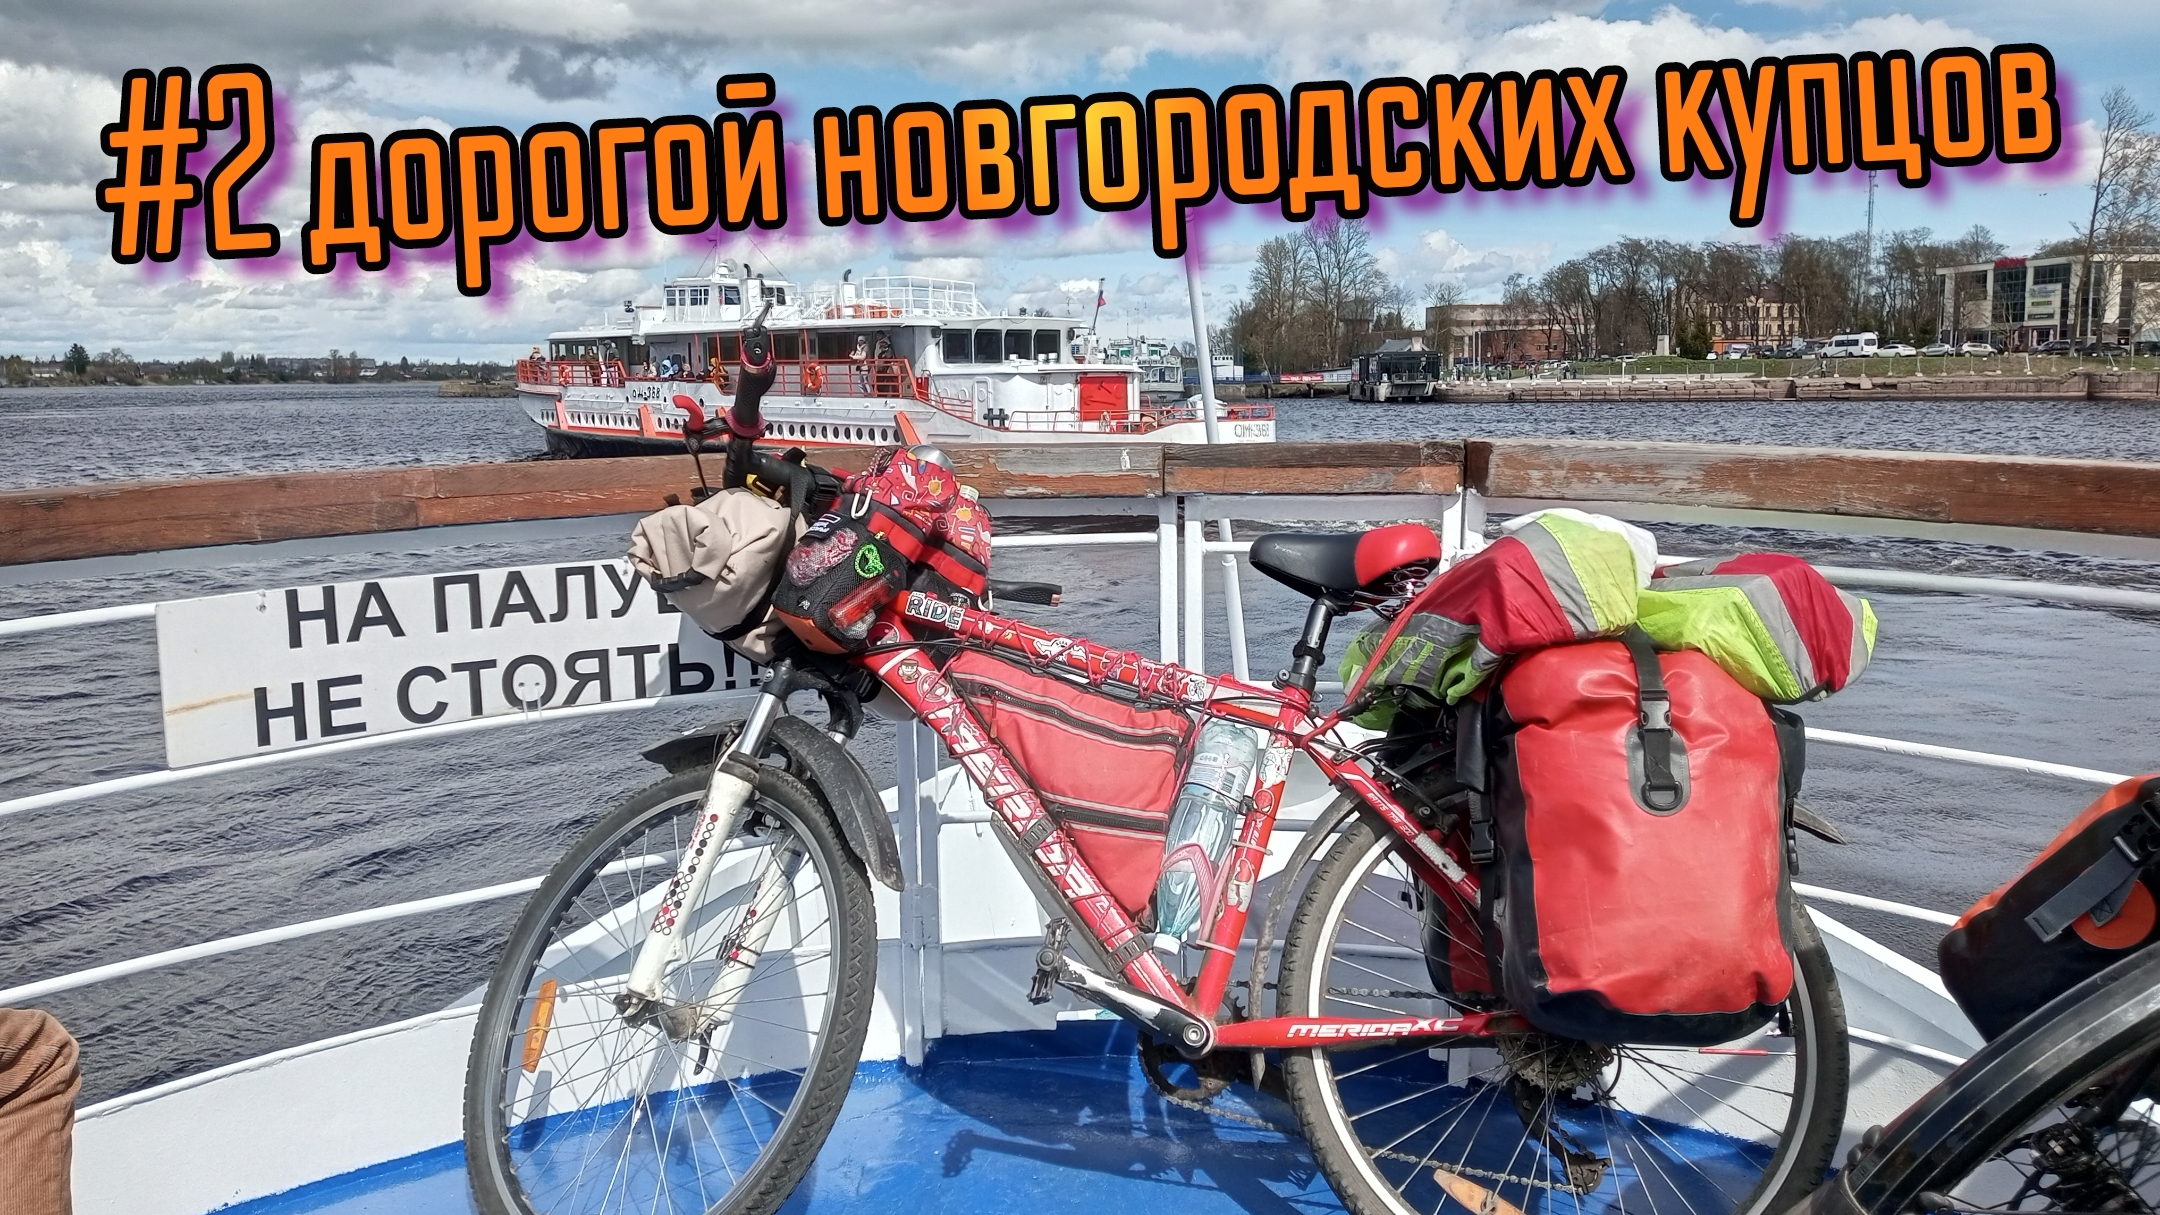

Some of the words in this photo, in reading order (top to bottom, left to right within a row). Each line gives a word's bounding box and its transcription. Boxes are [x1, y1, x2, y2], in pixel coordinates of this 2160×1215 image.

[286, 582, 405, 649] НА
[906, 595, 963, 626] RIDE
[253, 675, 367, 747] НЕ
[1287, 1023, 1413, 1038] MERIDA
[1412, 1017, 1464, 1031] XC
